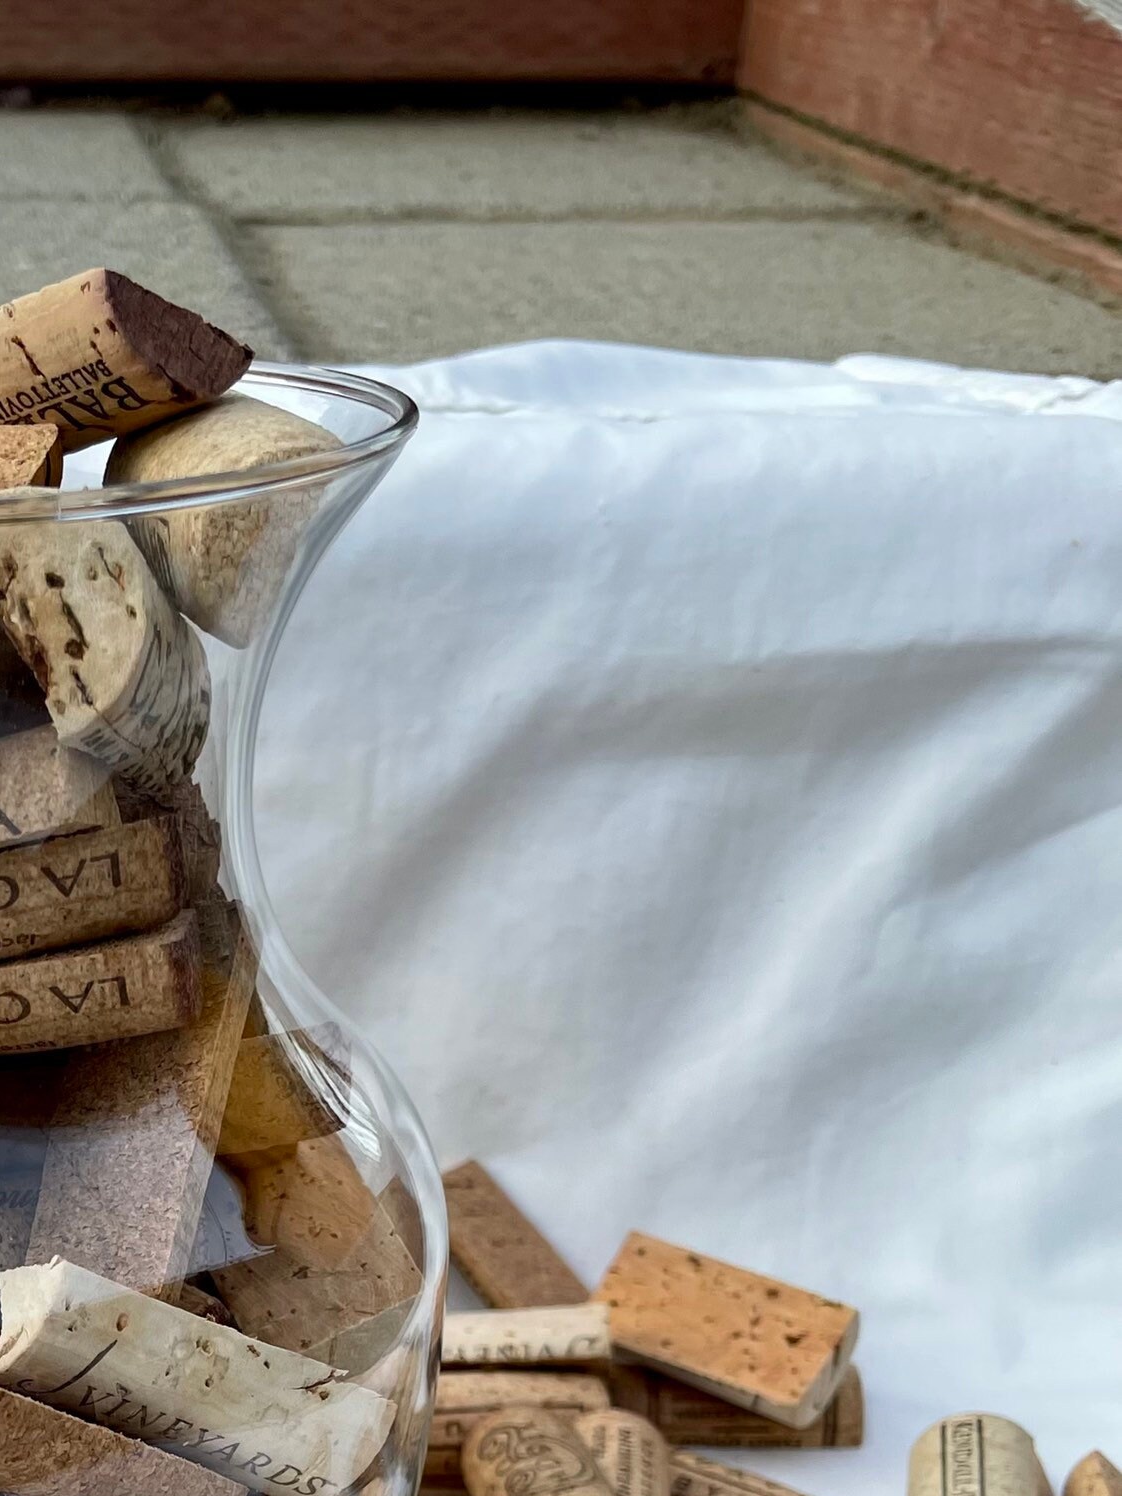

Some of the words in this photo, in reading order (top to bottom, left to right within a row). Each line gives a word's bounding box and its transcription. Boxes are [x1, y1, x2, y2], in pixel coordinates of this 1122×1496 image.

[40, 849, 124, 899] LA
[48, 975, 132, 1016] LA
[77, 1384, 339, 1496] VINEYARDS
